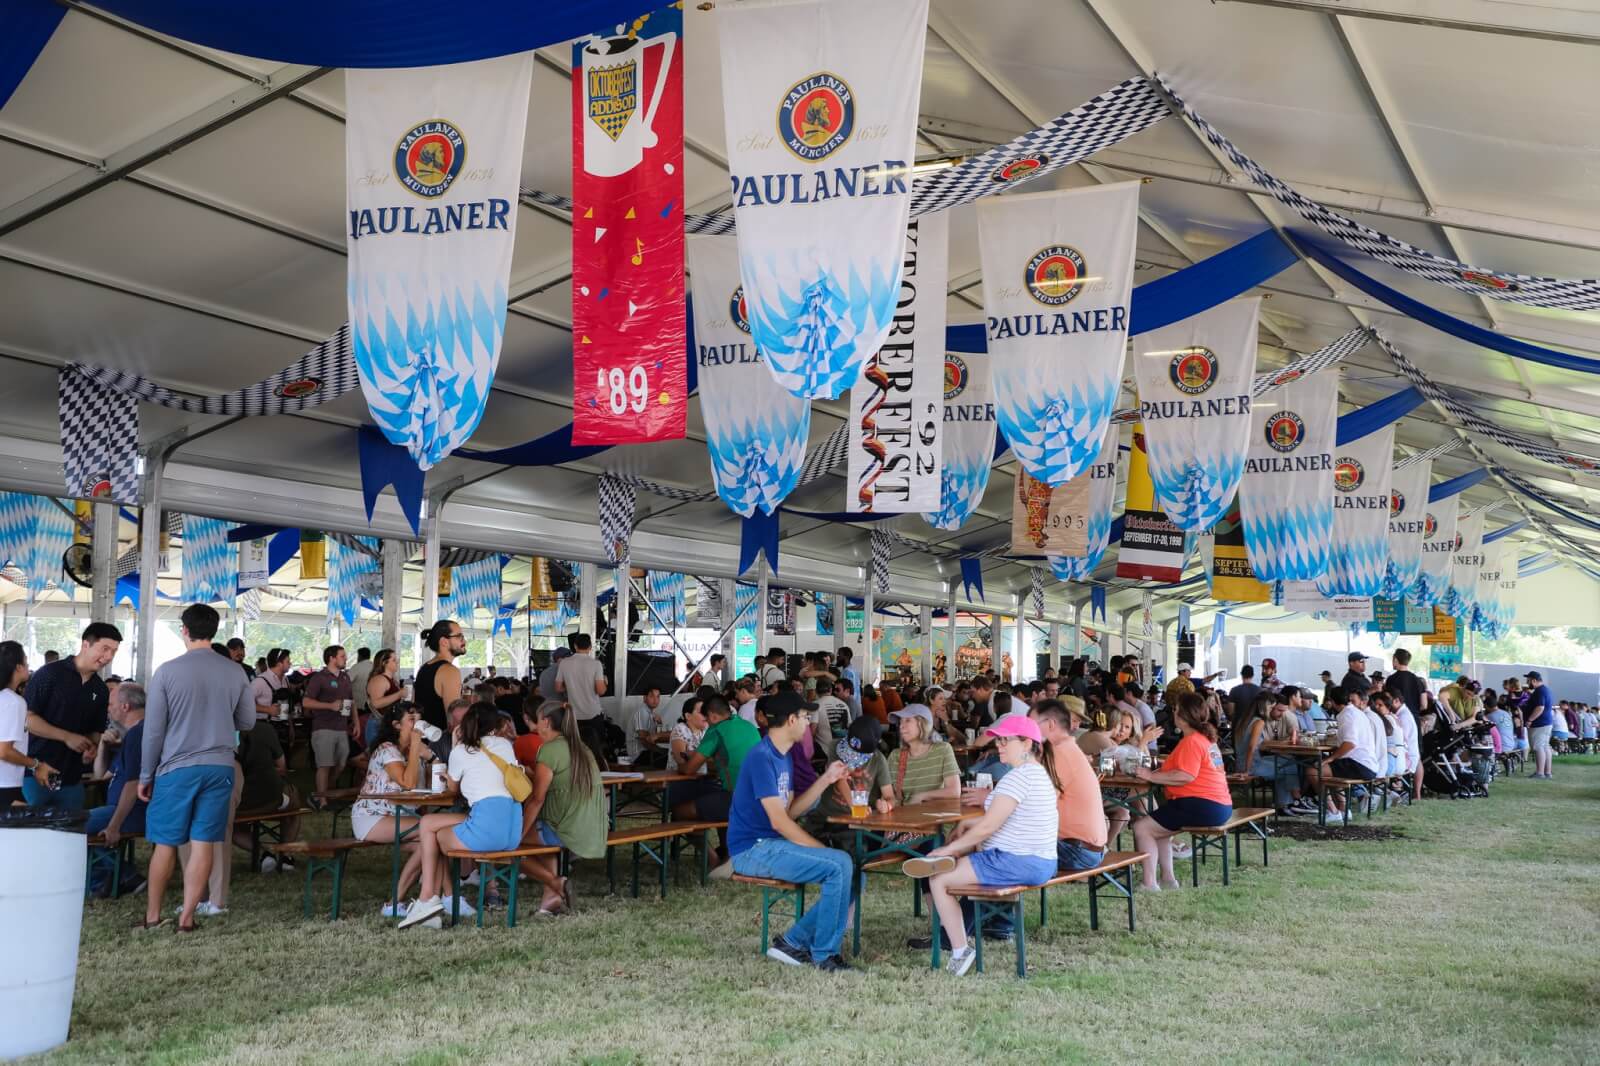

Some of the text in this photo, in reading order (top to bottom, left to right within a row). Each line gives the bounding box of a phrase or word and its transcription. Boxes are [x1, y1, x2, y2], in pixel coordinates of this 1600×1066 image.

[783, 75, 851, 110] PAULANER
[400, 122, 464, 151] PAULANER
[1028, 247, 1083, 271] PAULANER
[1243, 454, 1332, 474] AULANER
